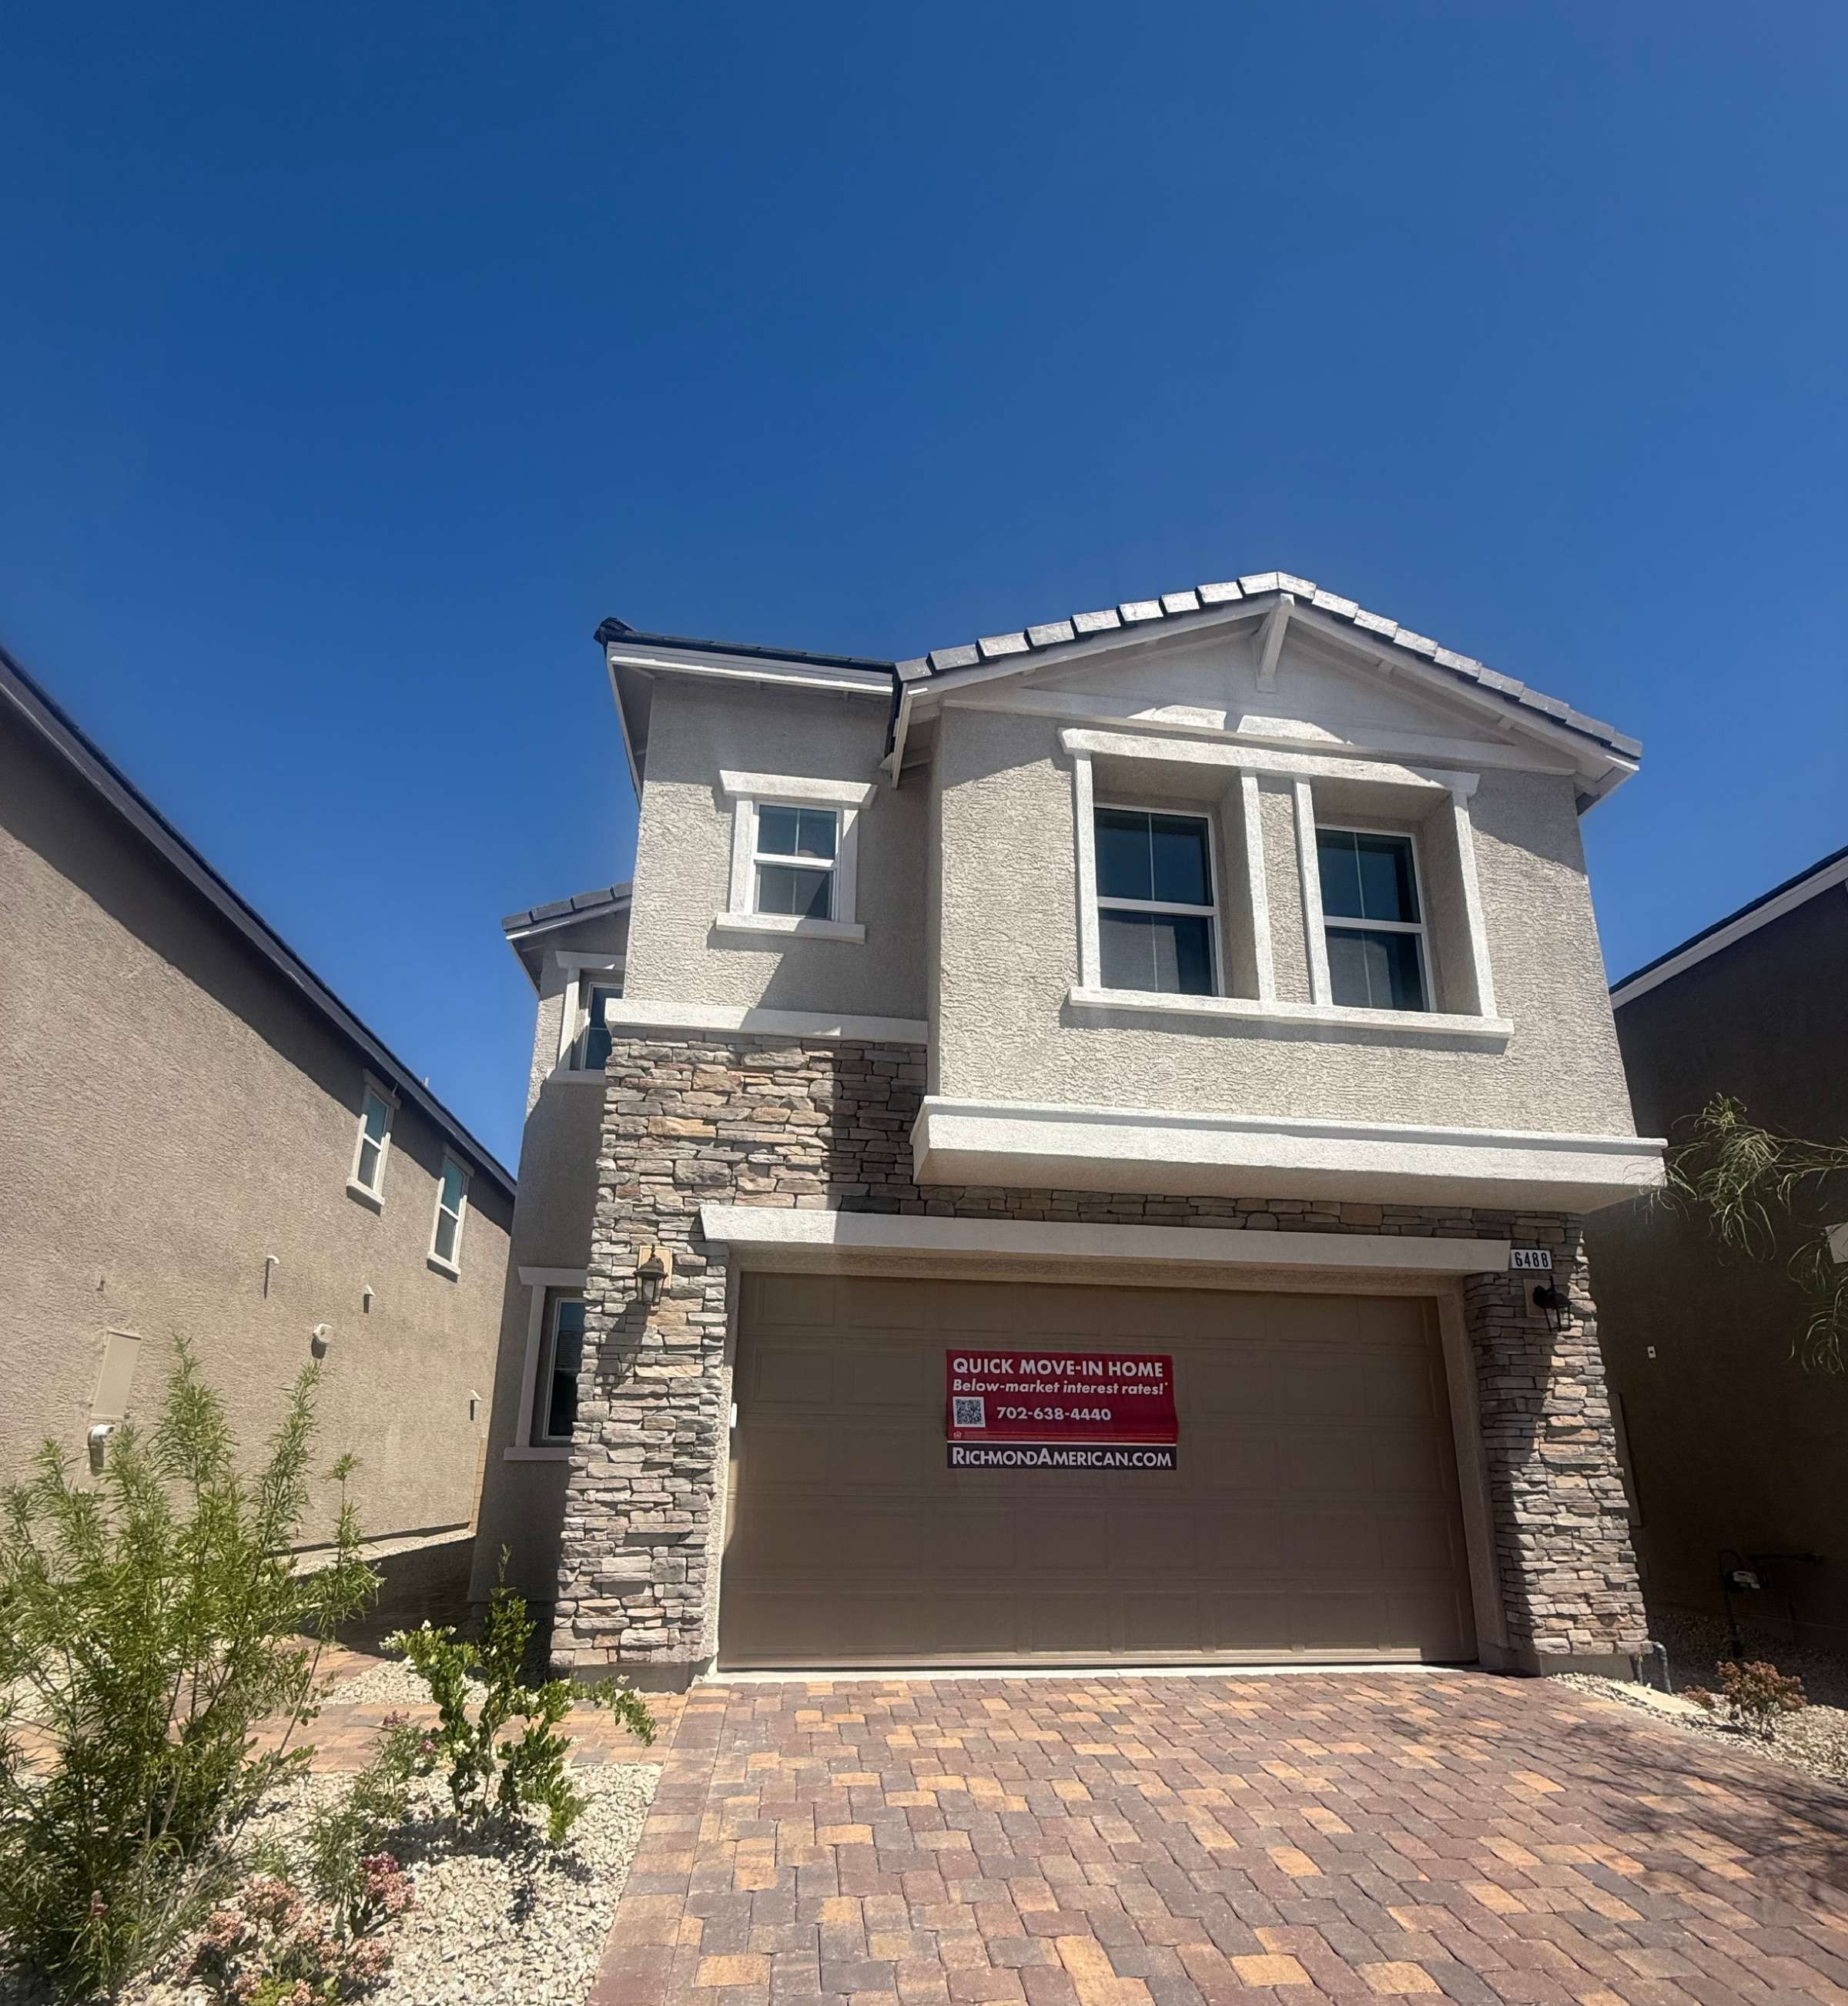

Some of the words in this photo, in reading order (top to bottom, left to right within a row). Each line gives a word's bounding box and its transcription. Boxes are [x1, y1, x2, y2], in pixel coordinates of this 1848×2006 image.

[1515, 1251, 1548, 1268] 6488
[952, 1358, 1014, 1375] QUICK
[1019, 1359, 1103, 1376] MOVE-IN
[1108, 1361, 1163, 1377] HOME
[952, 1378, 1060, 1393] Below-market
[1063, 1381, 1119, 1395] interest
[996, 1406, 1111, 1421] 702-638-4440
